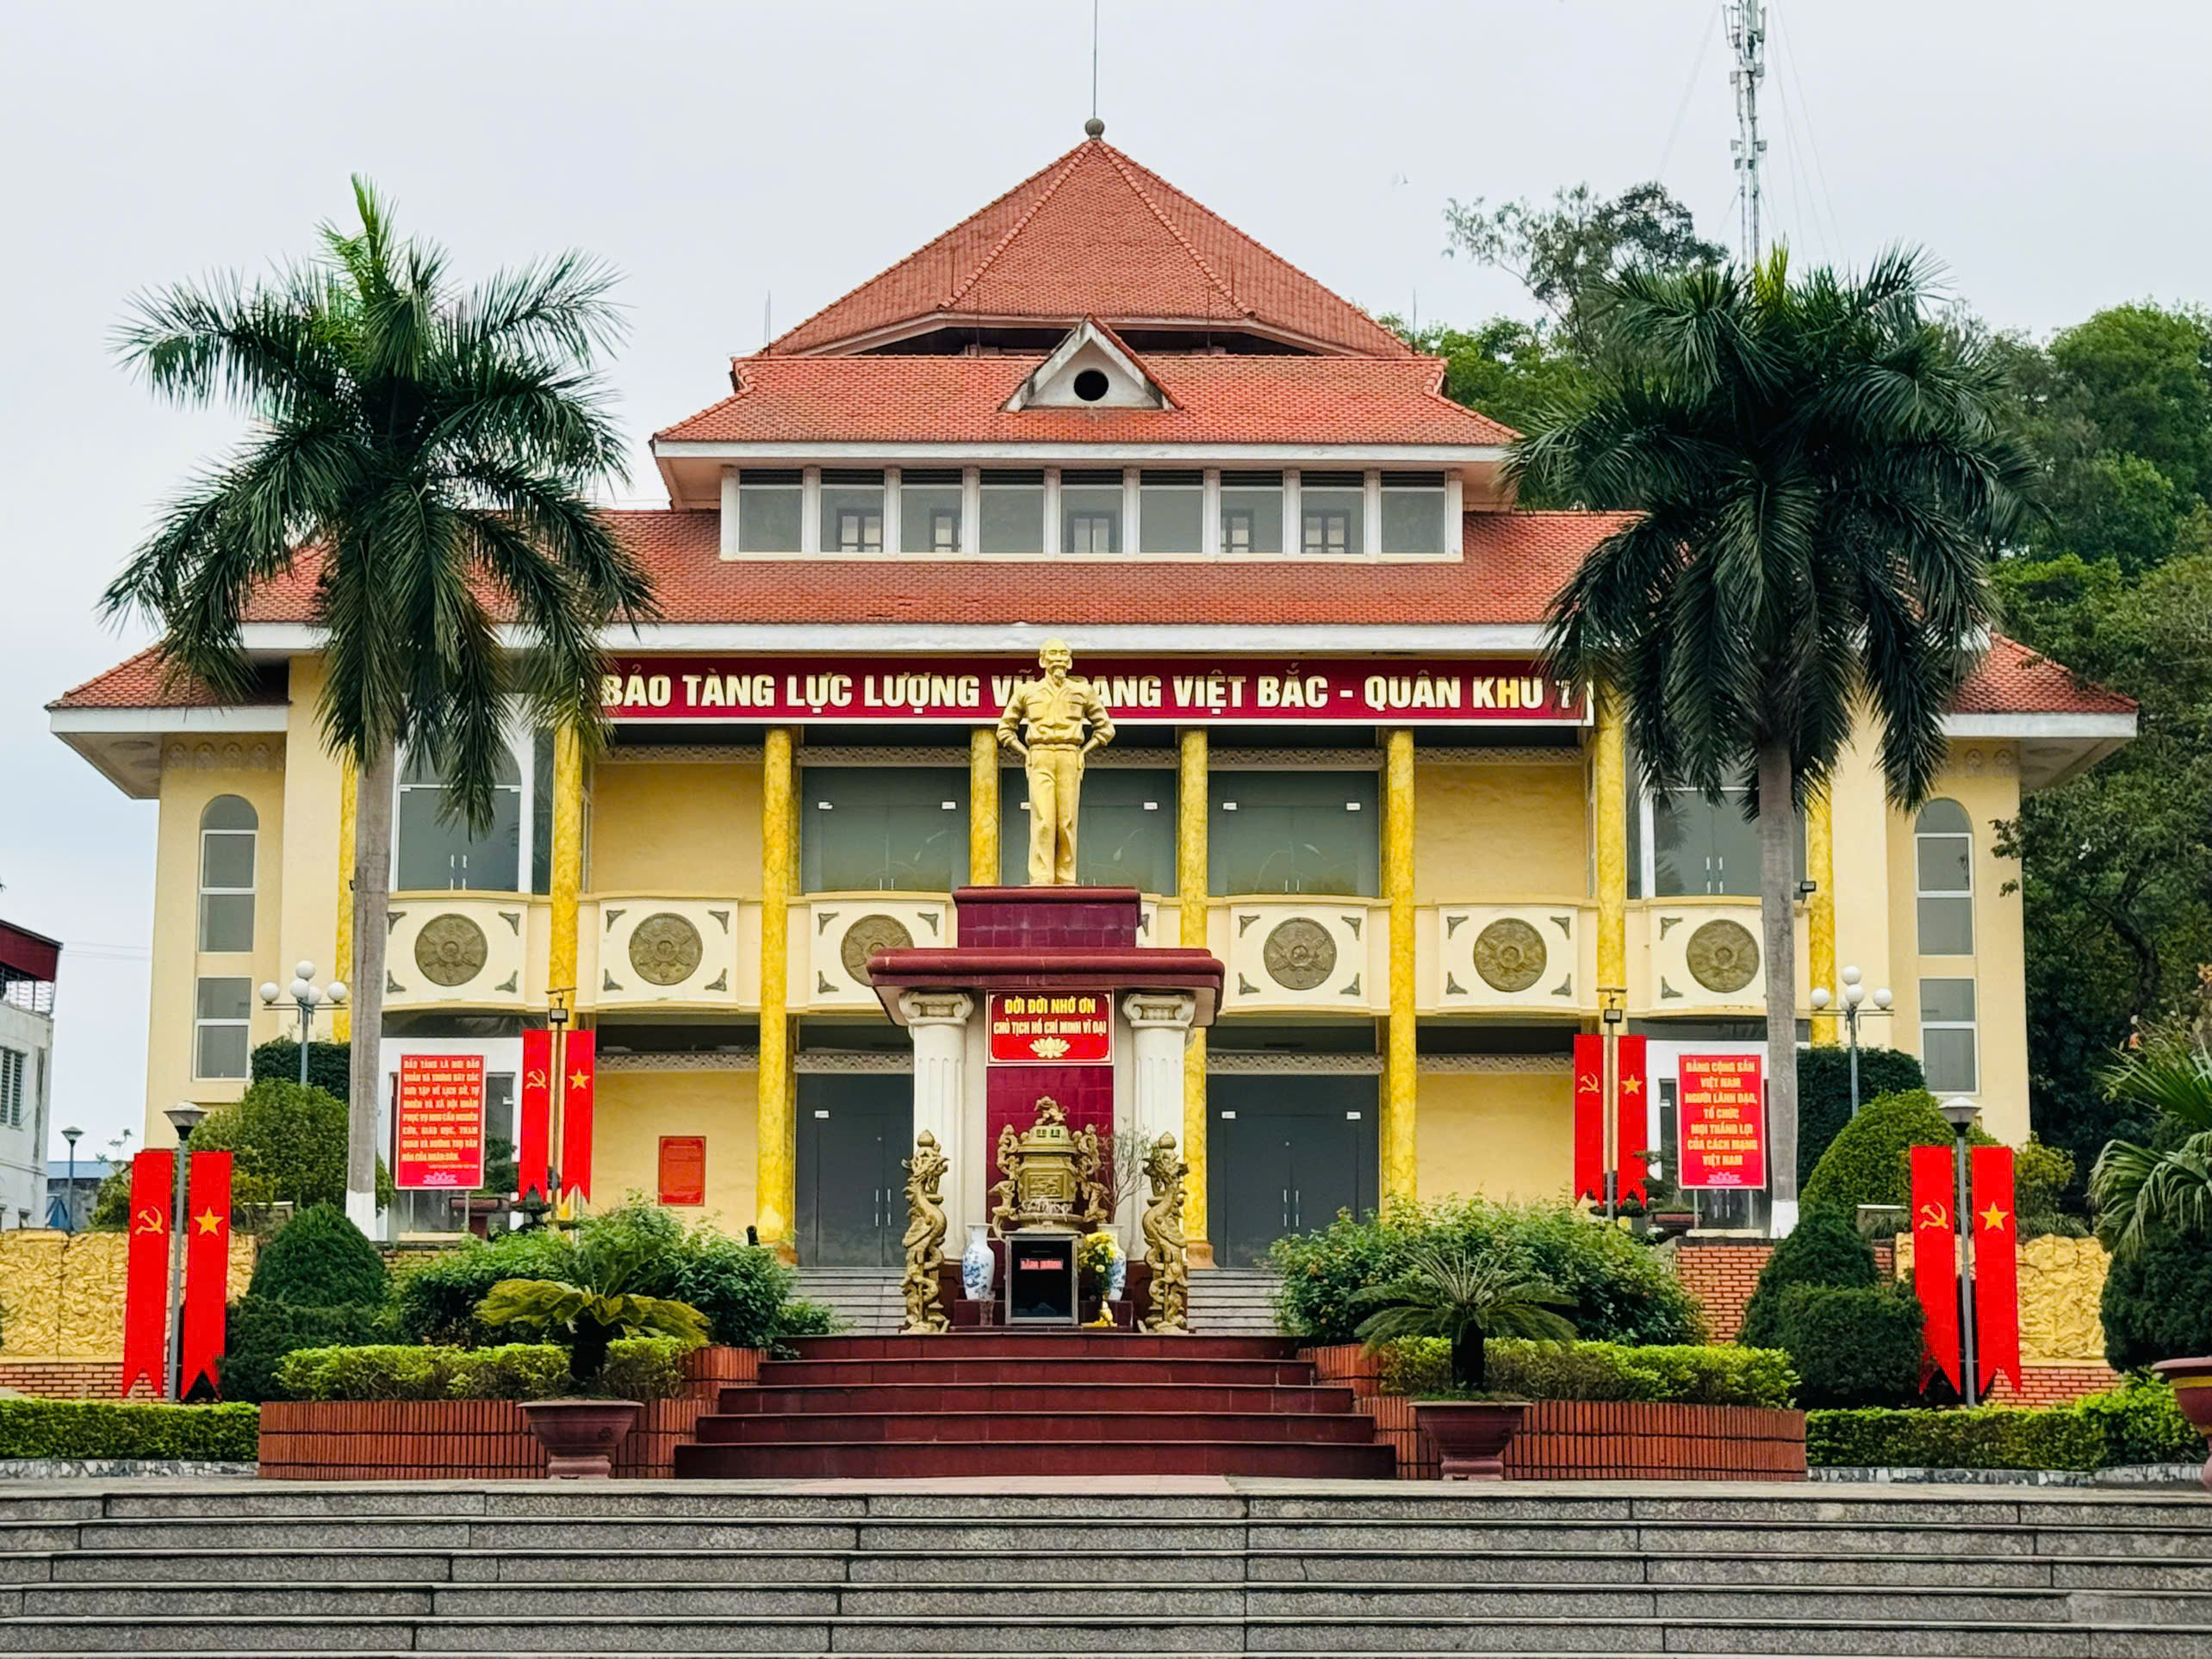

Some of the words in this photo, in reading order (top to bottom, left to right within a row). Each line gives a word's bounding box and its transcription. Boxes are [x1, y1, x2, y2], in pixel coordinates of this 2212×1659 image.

[601, 663, 672, 707] BẢO
[683, 668, 775, 707] TÀNG
[786, 670, 853, 714] LỰC
[864, 670, 980, 714] LƯỢNG
[1068, 675, 1161, 707] ANG
[1173, 669, 1246, 714] VIỆT
[1258, 662, 1328, 708] BẮC
[1364, 669, 1461, 711] QUÂN
[1473, 674, 1544, 709] KHU
[1004, 995, 1025, 1014] ĐỜI
[1028, 995, 1047, 1014] ĐỜI
[1051, 996, 1077, 1014] NHỚ
[1078, 997, 1096, 1014] ƠN
[1700, 1076, 1718, 1090] VIỆT
[1720, 1078, 1741, 1088] NAM
[1702, 1153, 1720, 1167] VIỆT
[1723, 1155, 1743, 1165] NAM
